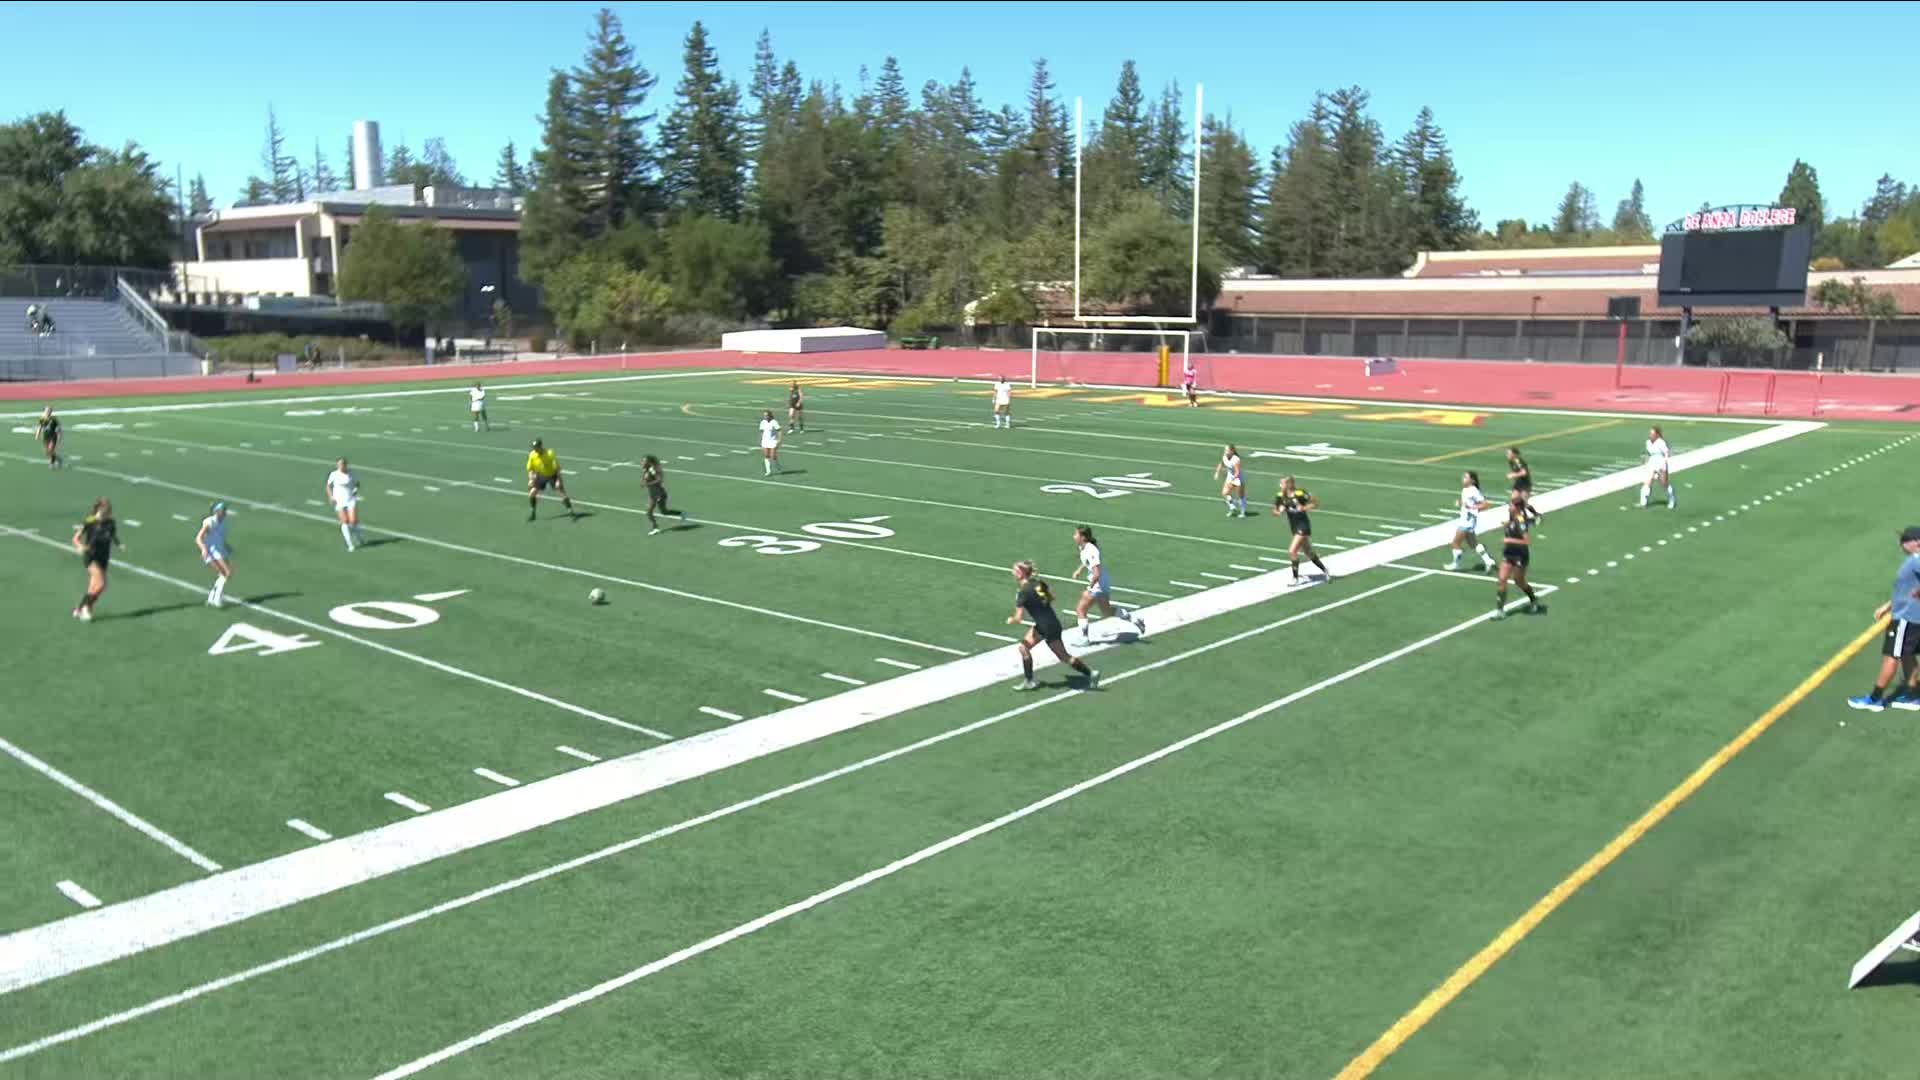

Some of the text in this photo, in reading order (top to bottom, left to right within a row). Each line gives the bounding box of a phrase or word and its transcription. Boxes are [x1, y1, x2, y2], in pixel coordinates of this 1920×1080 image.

[1039, 475, 1173, 499] 20
[717, 521, 896, 555] 30
[207, 600, 441, 657] 40
